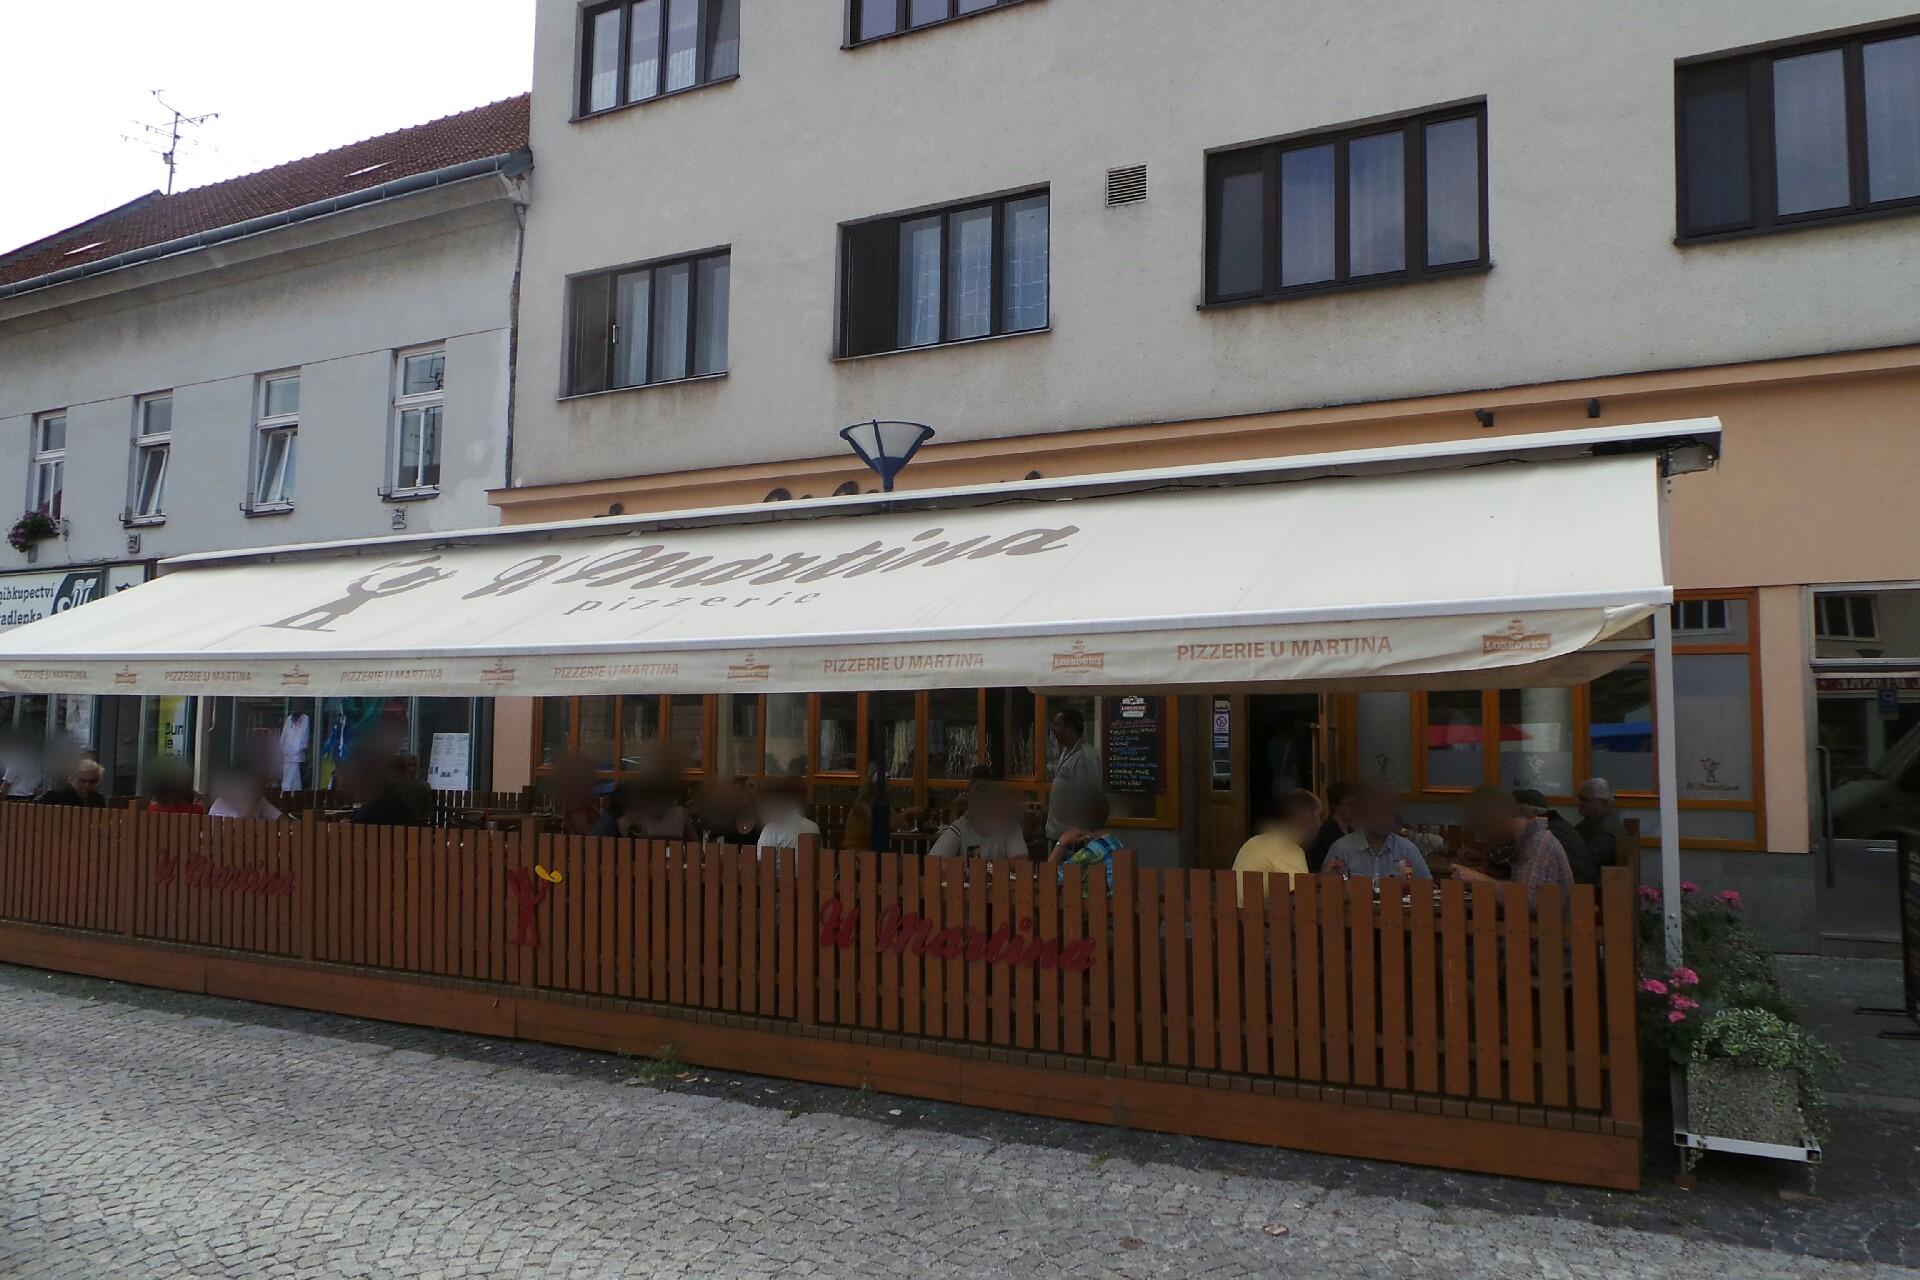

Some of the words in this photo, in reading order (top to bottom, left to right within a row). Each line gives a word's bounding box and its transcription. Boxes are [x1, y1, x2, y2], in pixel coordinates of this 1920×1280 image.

[552, 525, 1080, 589] Martina
[563, 591, 821, 615] pizzerie
[1177, 642, 1265, 661] PIZZERIE
[1270, 641, 1284, 657] U
[1291, 636, 1393, 657] MARTINA
[553, 665, 605, 679] PIZZERIE
[619, 663, 680, 677] MARTINA
[823, 656, 889, 673] PIZZERIE
[894, 656, 905, 670] U
[909, 653, 984, 669] MARTINA
[165, 671, 201, 682] PIZZERIE
[341, 671, 384, 682] PIZZERIE
[394, 669, 442, 681] MARTINA
[876, 903, 1096, 972] Martina
